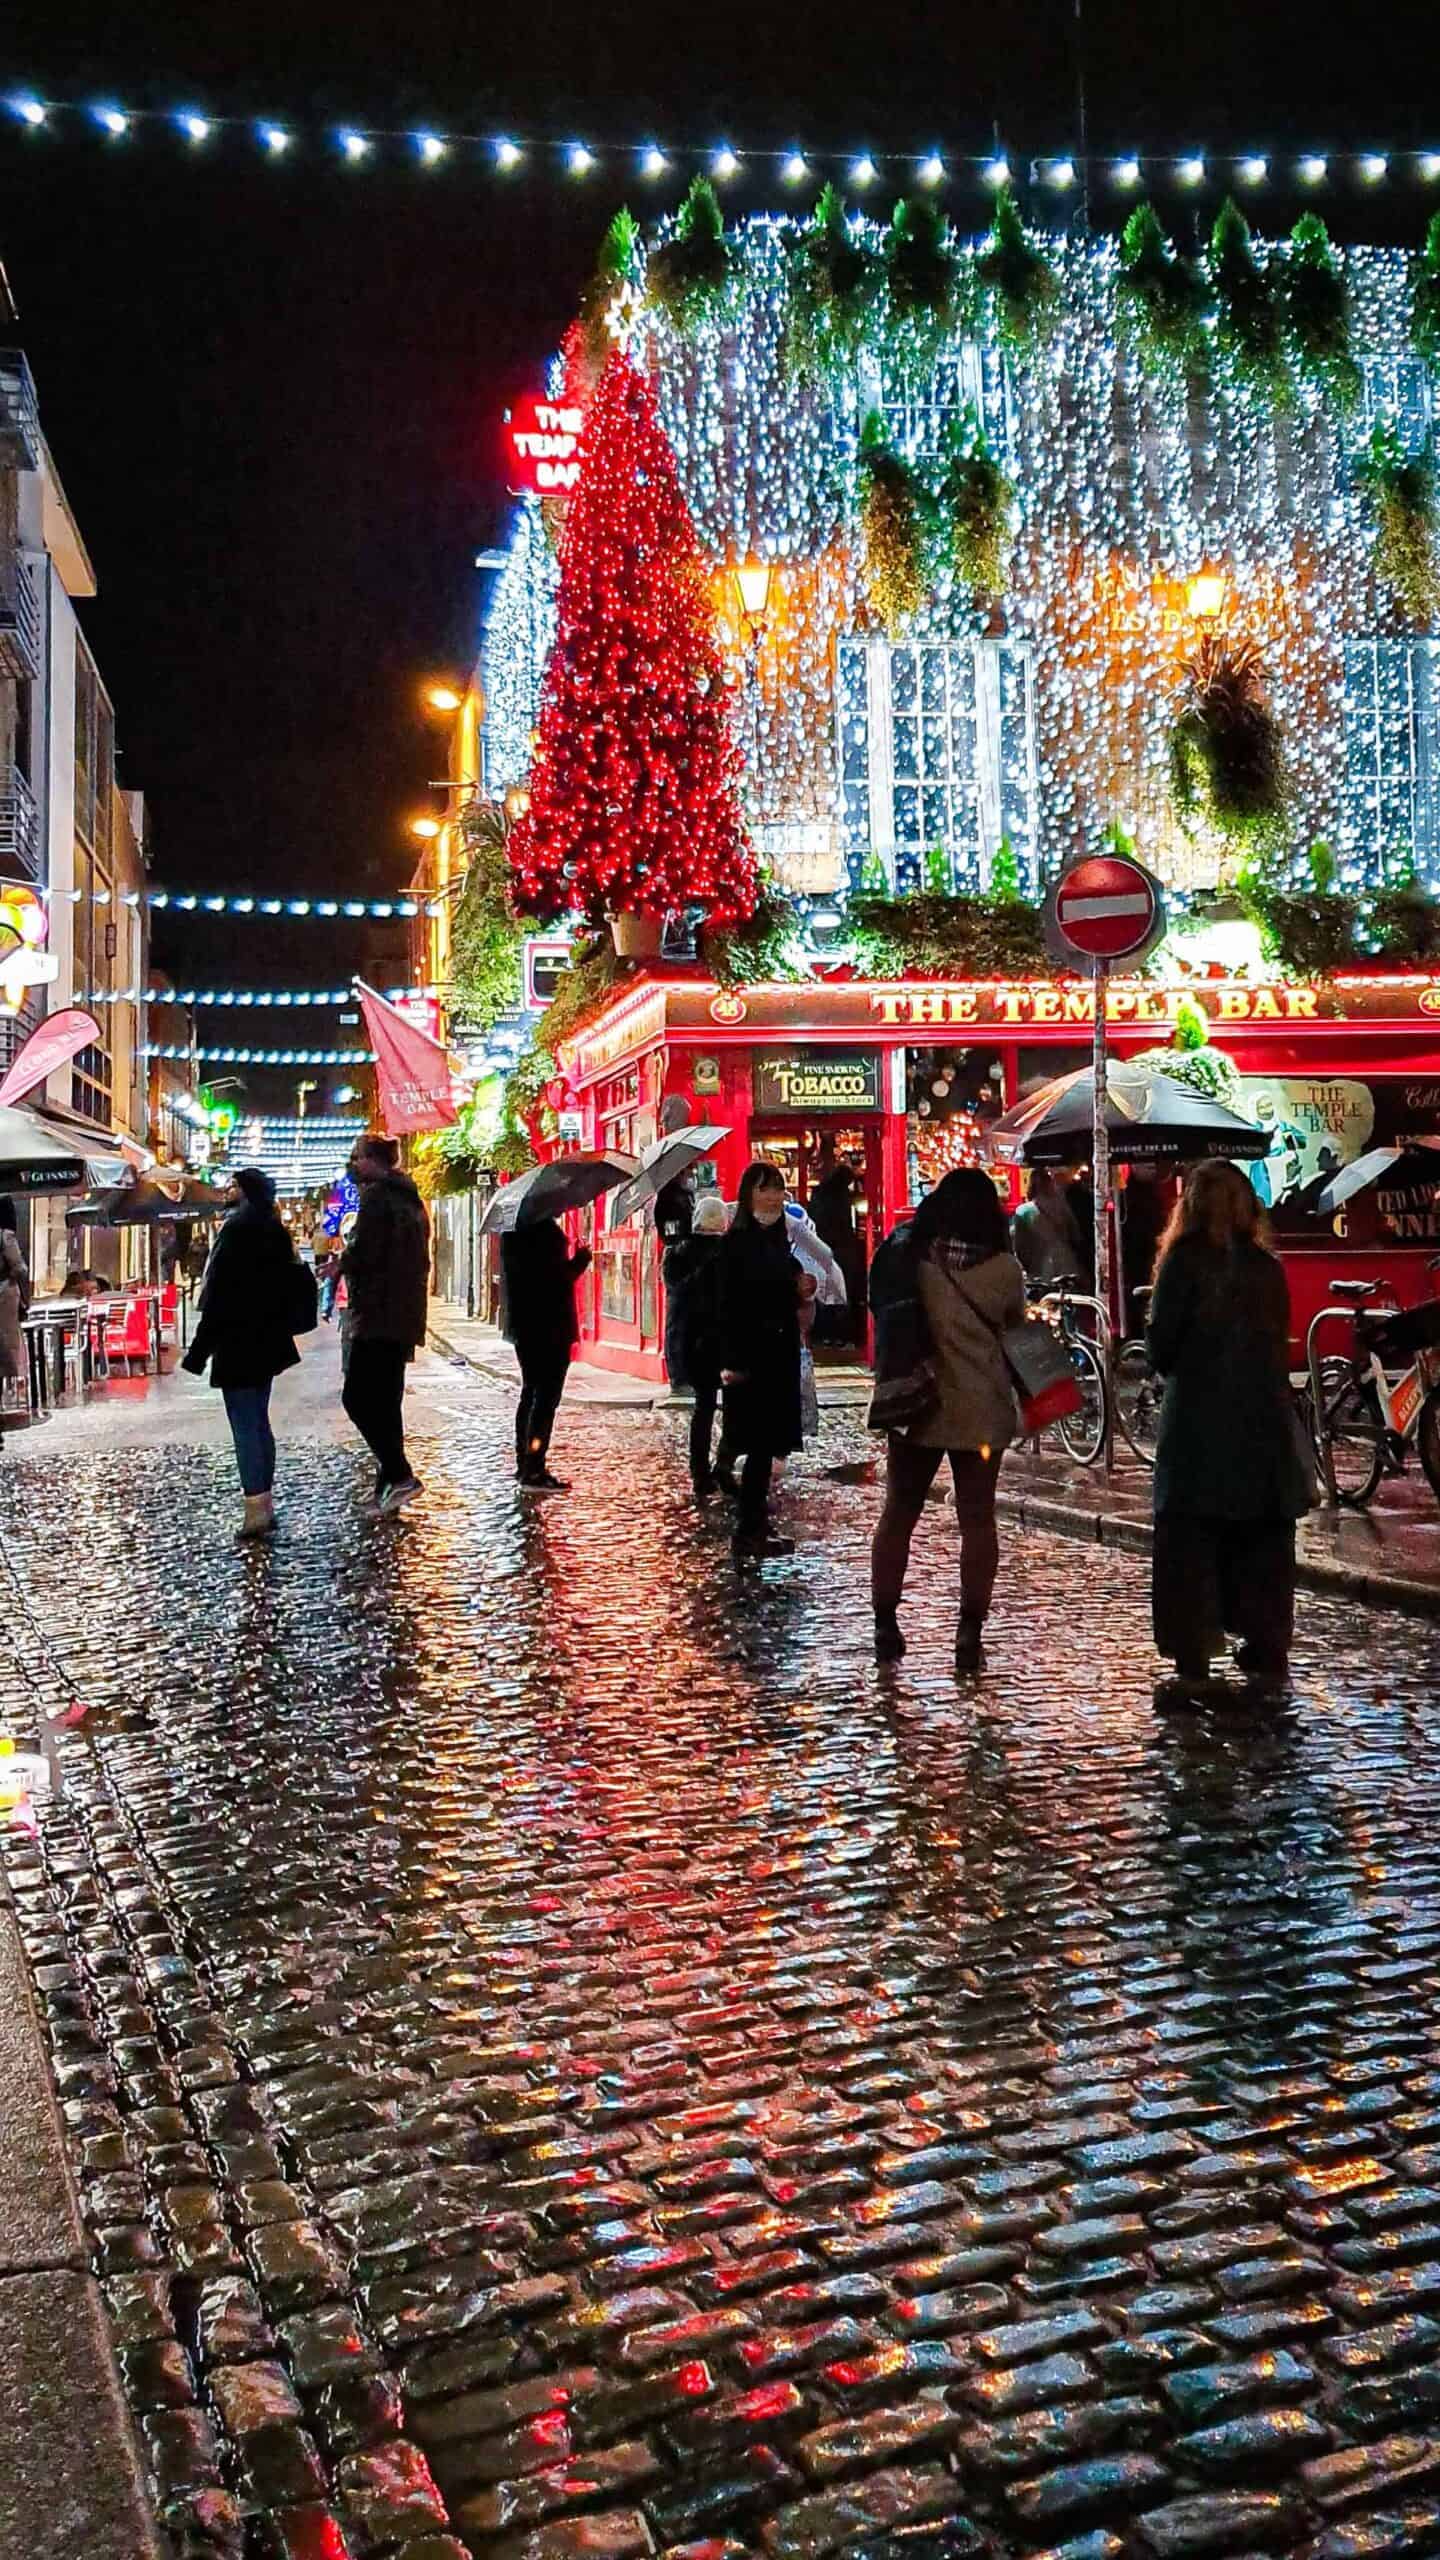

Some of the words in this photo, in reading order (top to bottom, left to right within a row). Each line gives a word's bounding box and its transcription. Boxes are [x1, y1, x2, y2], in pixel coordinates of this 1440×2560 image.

[534, 405, 583, 433] THE
[717, 996, 740, 1017] 48
[871, 992, 978, 1023] THE
[1216, 990, 1318, 1019] BAR
[772, 1070, 866, 1104] TOBACCO
[1308, 1086, 1345, 1102] THE
[1291, 1102, 1363, 1118] TEMPLE
[1310, 1118, 1345, 1133] BAR
[31, 1169, 81, 1182] GUINNESS
